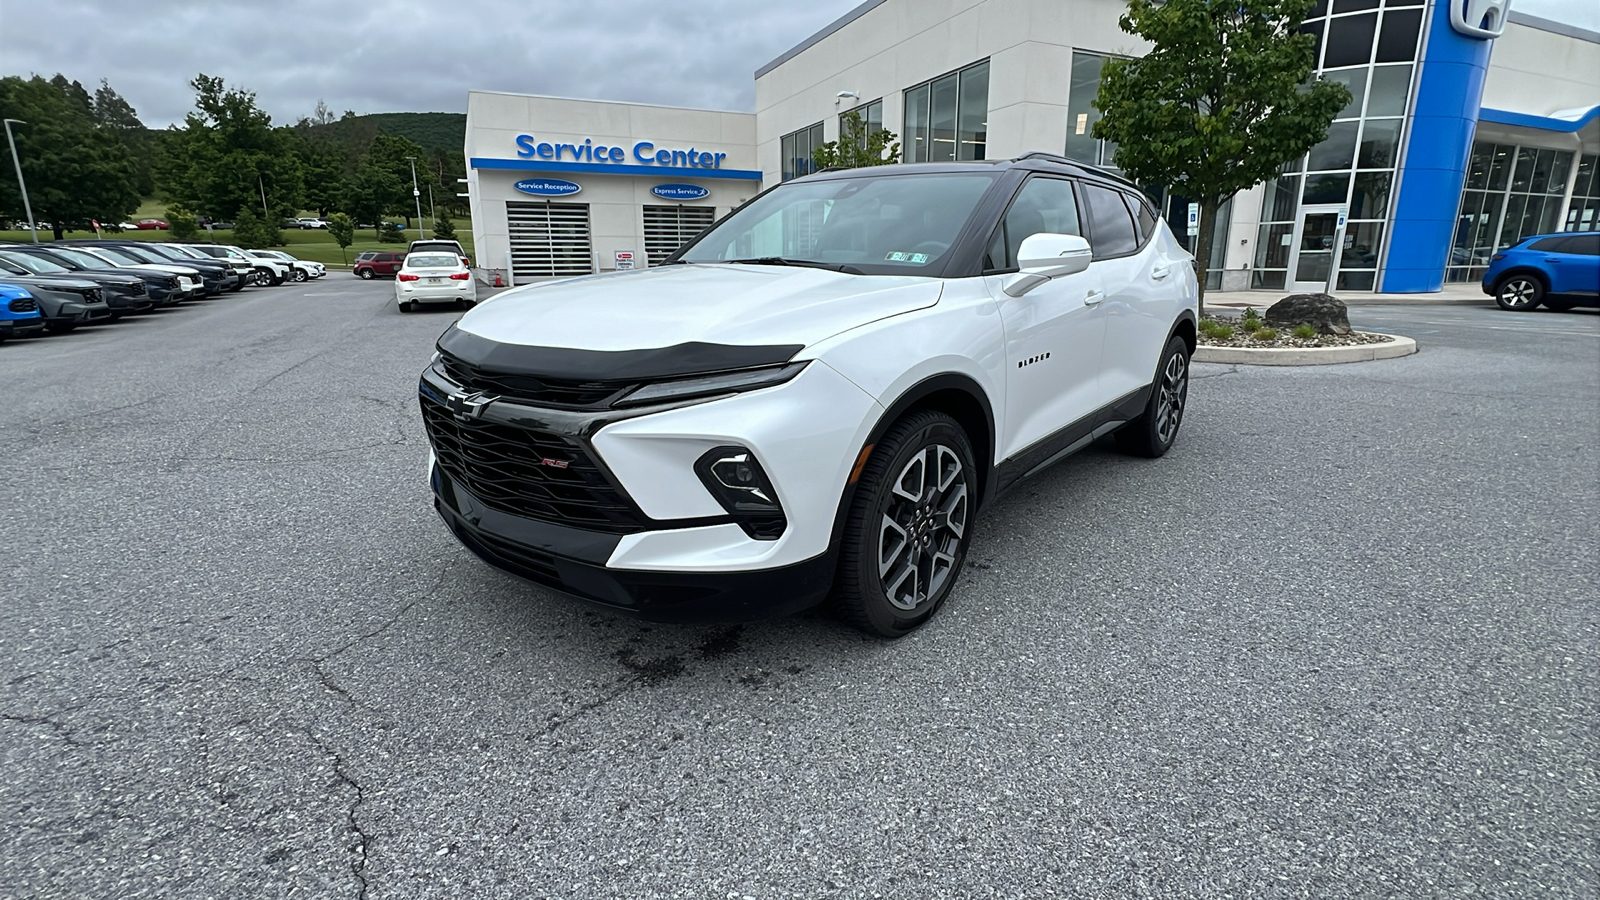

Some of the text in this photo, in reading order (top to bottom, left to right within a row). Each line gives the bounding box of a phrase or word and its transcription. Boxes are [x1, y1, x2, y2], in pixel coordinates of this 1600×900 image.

[516, 134, 726, 168] Service Center
[544, 183, 577, 191] Reception
[654, 187, 676, 195] Express
[1018, 352, 1051, 368] BLAZER
[541, 458, 569, 469] RS
